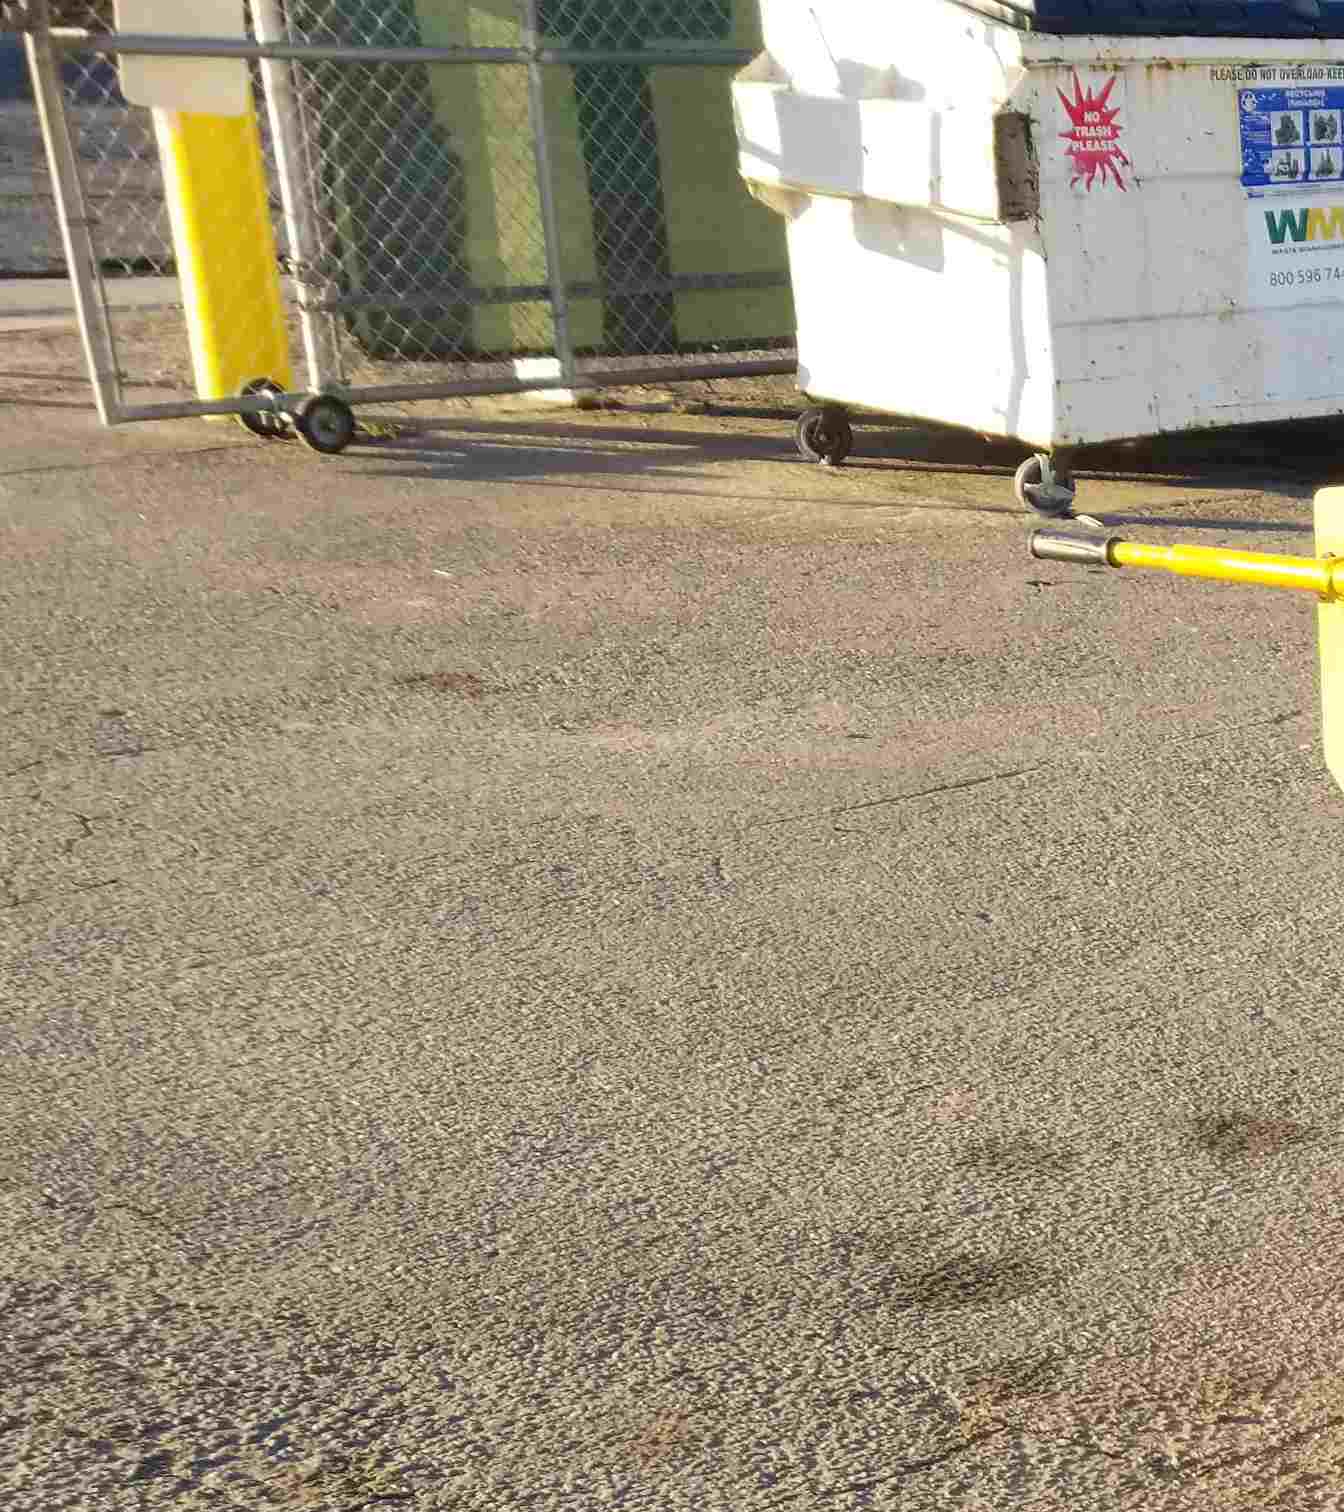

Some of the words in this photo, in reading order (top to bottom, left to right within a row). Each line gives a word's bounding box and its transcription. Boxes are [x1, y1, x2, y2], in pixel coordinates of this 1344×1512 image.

[1261, 68, 1277, 80] NOT
[1084, 111, 1100, 123] NO
[1072, 126, 1111, 137] TRASH
[1073, 140, 1114, 152] PLEASE
[1270, 271, 1294, 286] 800
